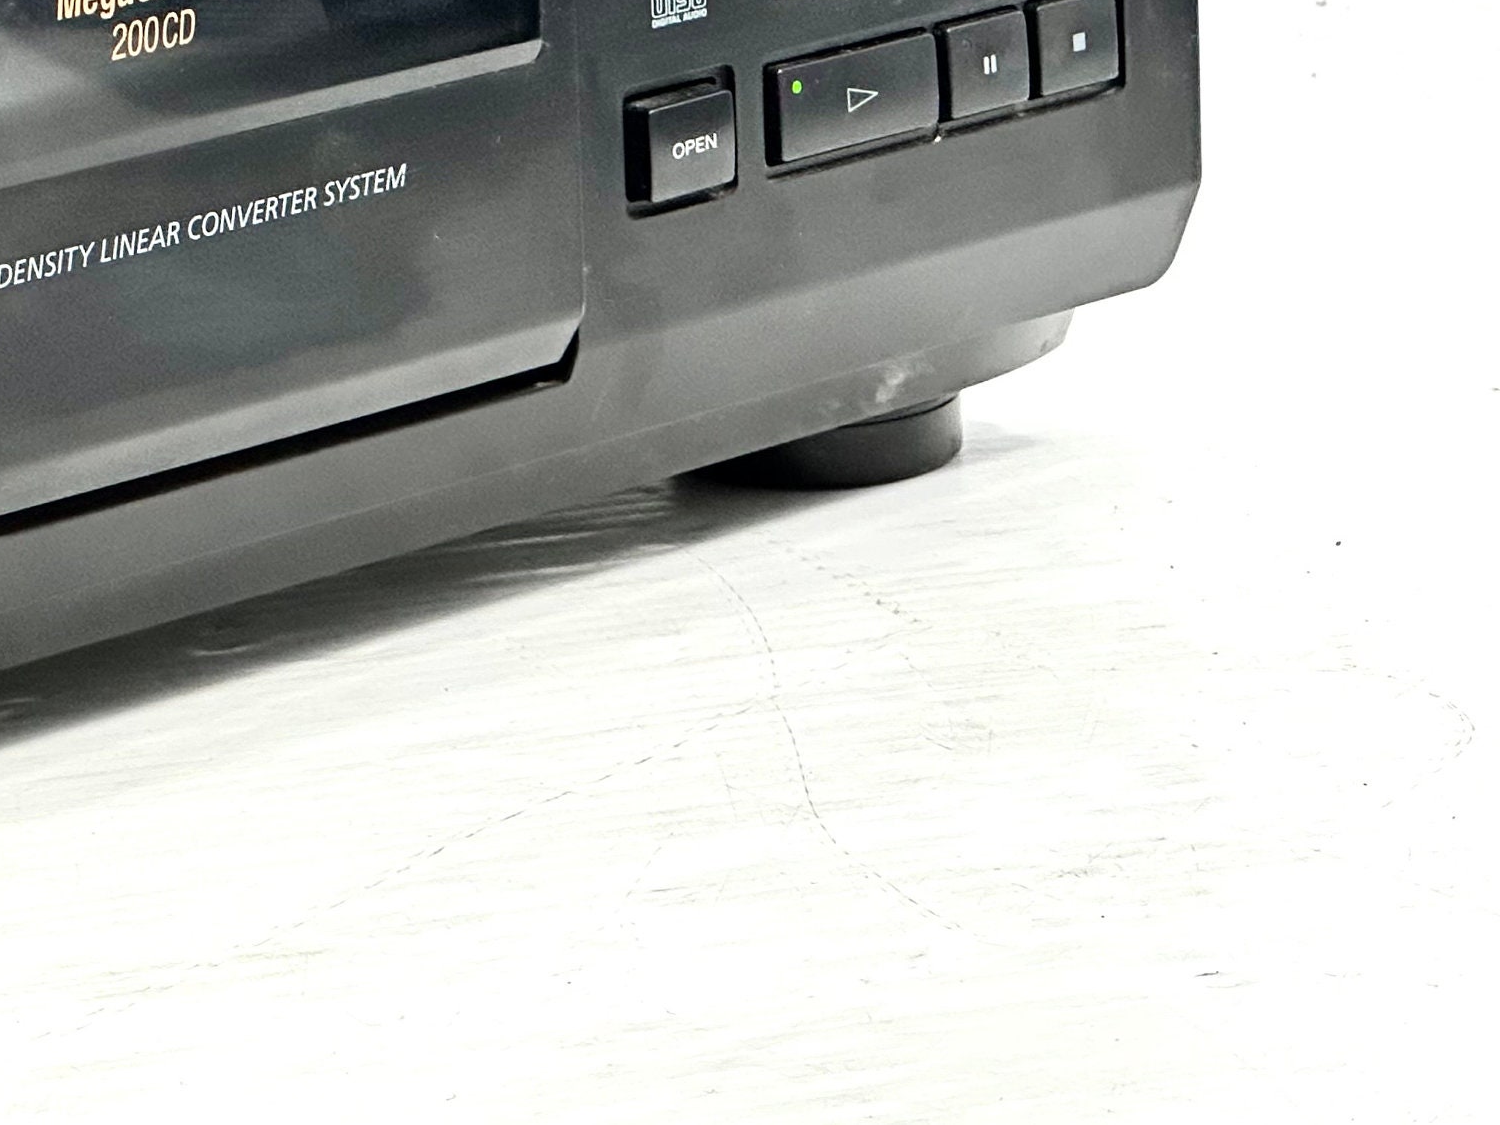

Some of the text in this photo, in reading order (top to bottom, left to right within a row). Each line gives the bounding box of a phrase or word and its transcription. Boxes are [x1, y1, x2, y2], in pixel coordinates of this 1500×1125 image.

[672, 132, 718, 161] OPEN
[99, 220, 181, 264] LINEAR
[186, 186, 318, 241] CONVERTER
[323, 162, 409, 208] SYSTEM
